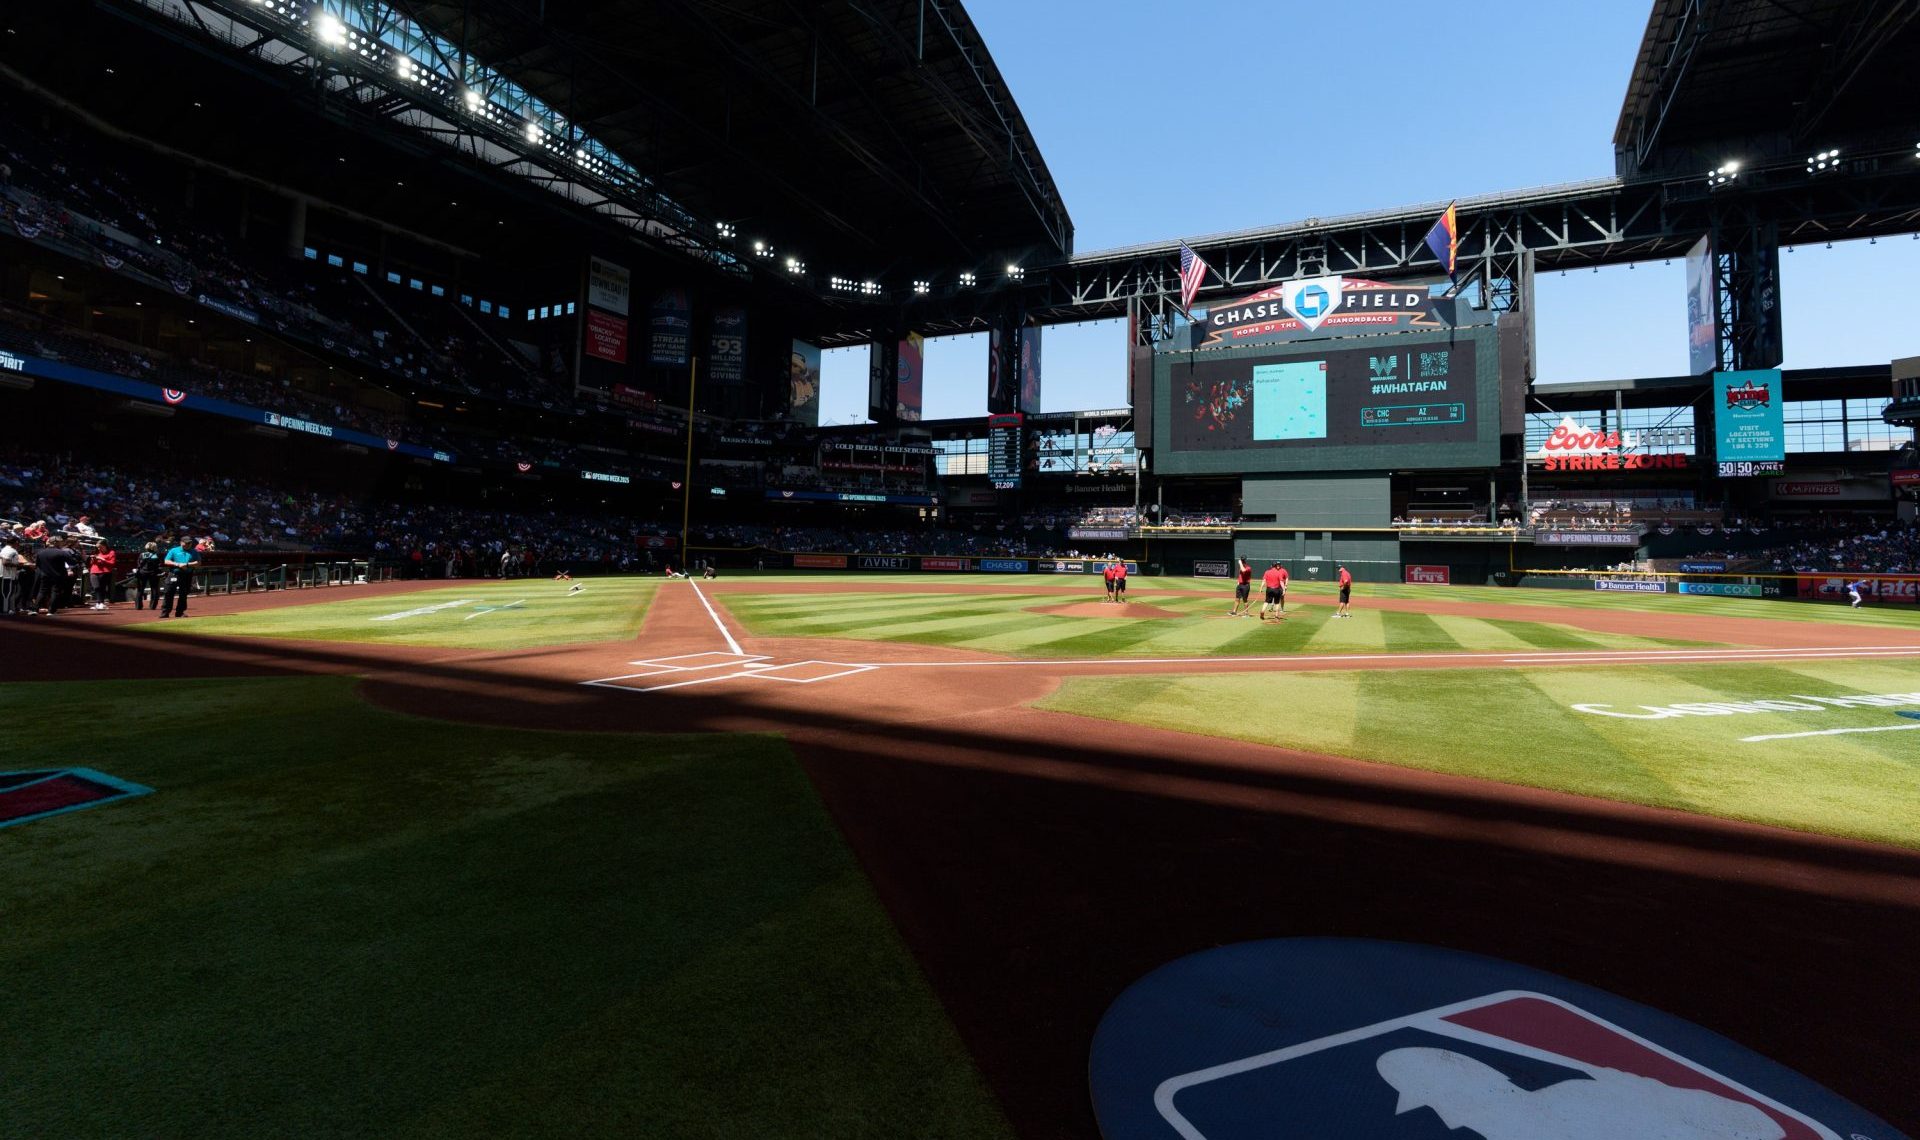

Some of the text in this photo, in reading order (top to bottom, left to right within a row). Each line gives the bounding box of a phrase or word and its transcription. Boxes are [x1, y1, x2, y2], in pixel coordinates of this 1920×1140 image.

[1214, 293, 1420, 326] CHASE FIELD
[1236, 315, 1393, 336] HOME OF THE DIAMONDBACKS
[711, 354, 742, 362] MILLION
[710, 371, 741, 379] GIVING
[1371, 380, 1447, 395] #WHATAFAN
[1377, 409, 1389, 417] CHC
[1418, 407, 1426, 416] AZ
[280, 415, 333, 437] OPENING WEEK 2025
[1545, 425, 1694, 450] Coors LIGHT
[884, 446, 945, 454] CHEESEBURGERS
[1545, 453, 1688, 471] STRIKE ZONE
[1074, 483, 1126, 493] Banner Health
[1561, 534, 1630, 543] OPENING WEEK 2025
[864, 558, 904, 567] AVNET
[1410, 567, 1444, 583] fry's
[1608, 582, 1660, 591] Banner Health
[1688, 584, 1714, 593] COX
[1724, 585, 1752, 594] COX
[1764, 586, 1780, 594] 374
